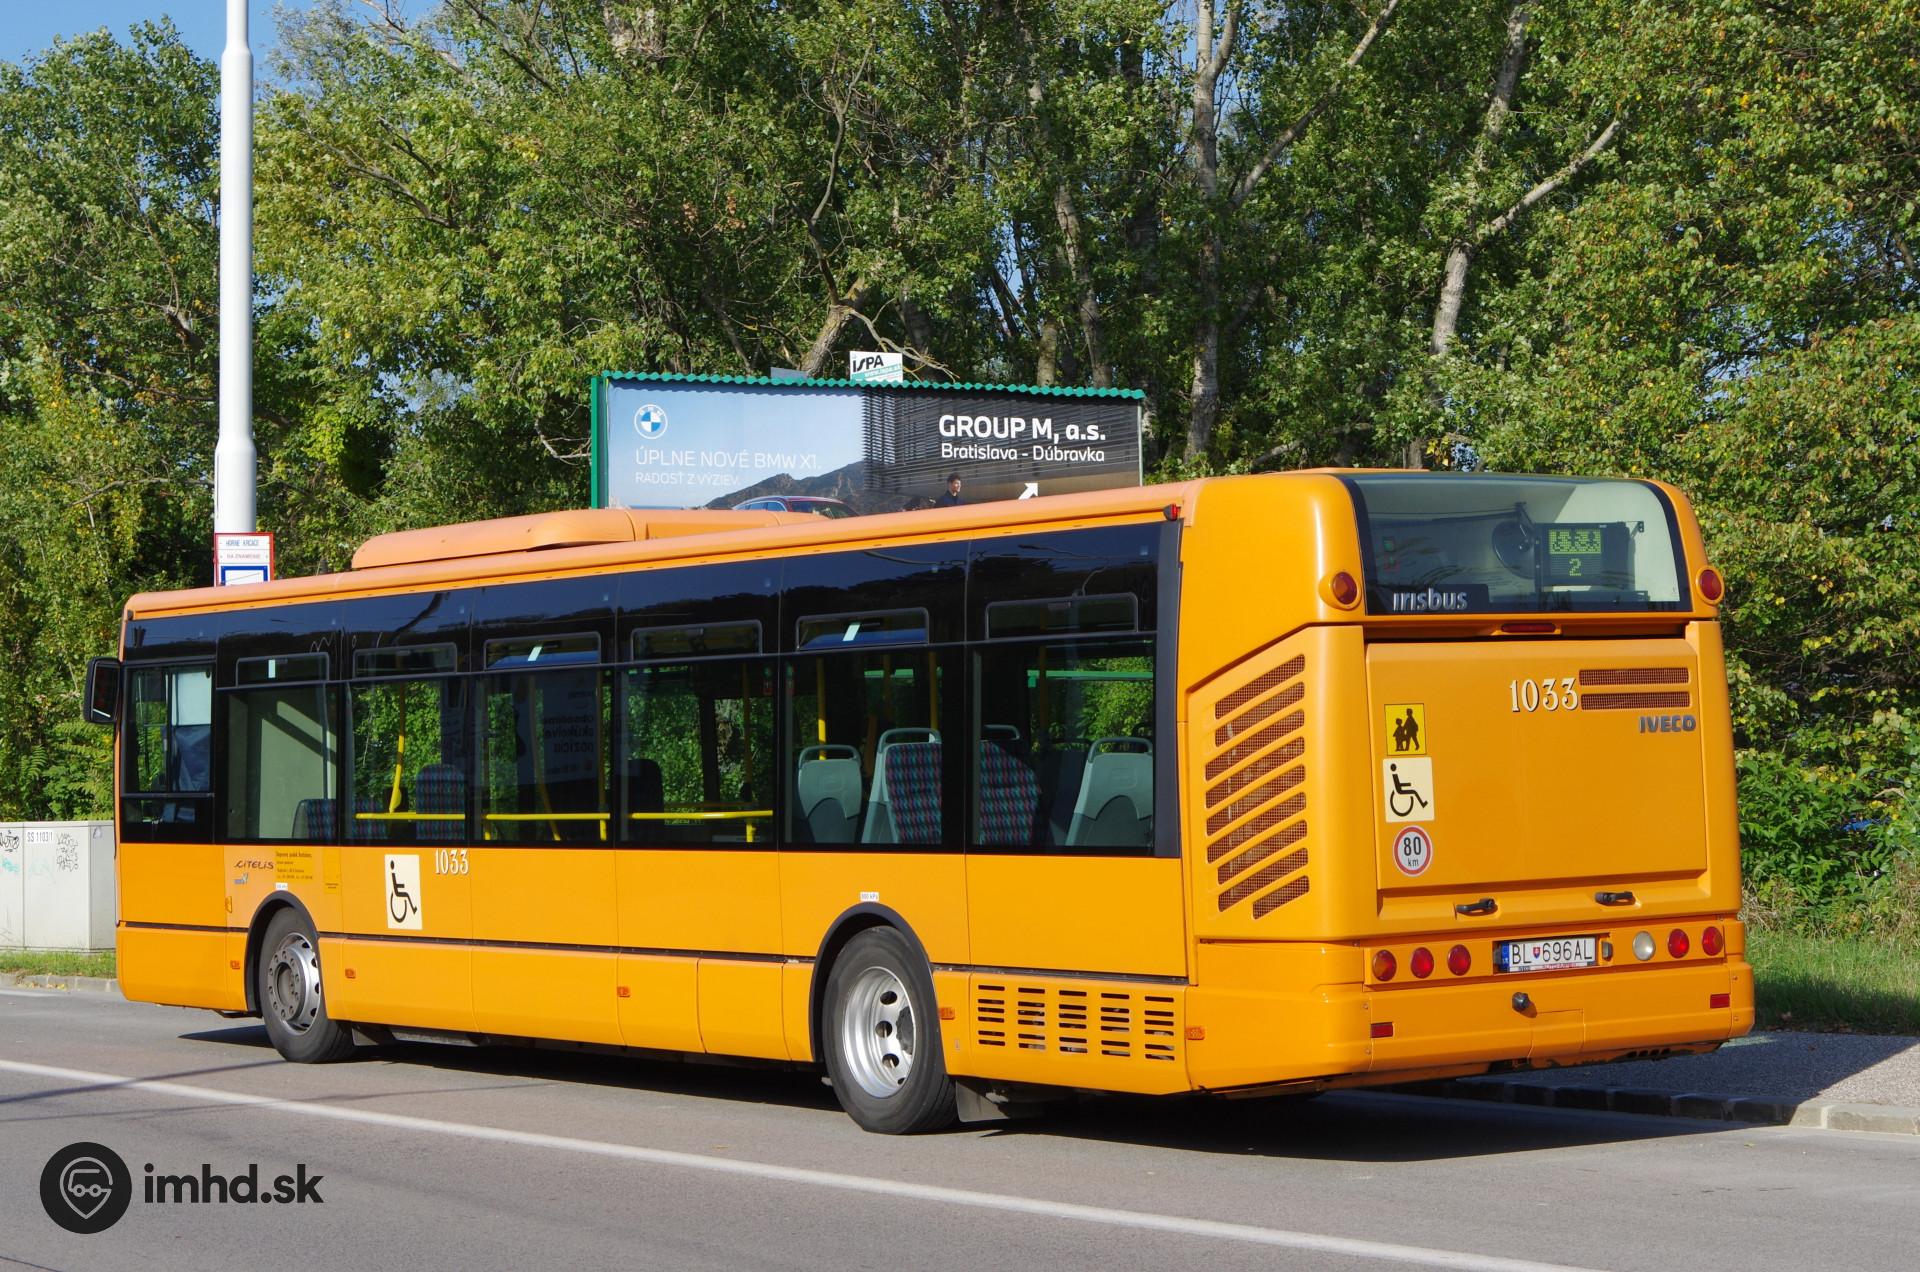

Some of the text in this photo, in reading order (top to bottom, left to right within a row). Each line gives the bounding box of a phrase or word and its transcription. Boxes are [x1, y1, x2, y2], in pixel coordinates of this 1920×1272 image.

[852, 355, 884, 373] ISPA
[939, 415, 1106, 444] GROUP M, a.s.
[635, 446, 696, 467] ÚPLNE
[700, 449, 749, 468] NOVÉ
[754, 453, 795, 469] BMW
[941, 443, 1018, 460] Bratislava
[1033, 446, 1105, 462] Dúbravka
[1569, 558, 1581, 576] 2
[1393, 588, 1467, 611] irisbus
[1509, 678, 1579, 713] 1033
[1639, 715, 1696, 734] IVECO
[1403, 836, 1421, 856] 80
[435, 848, 470, 875] 1033
[1408, 858, 1419, 867] km
[1512, 940, 1593, 965] BL 696AL
